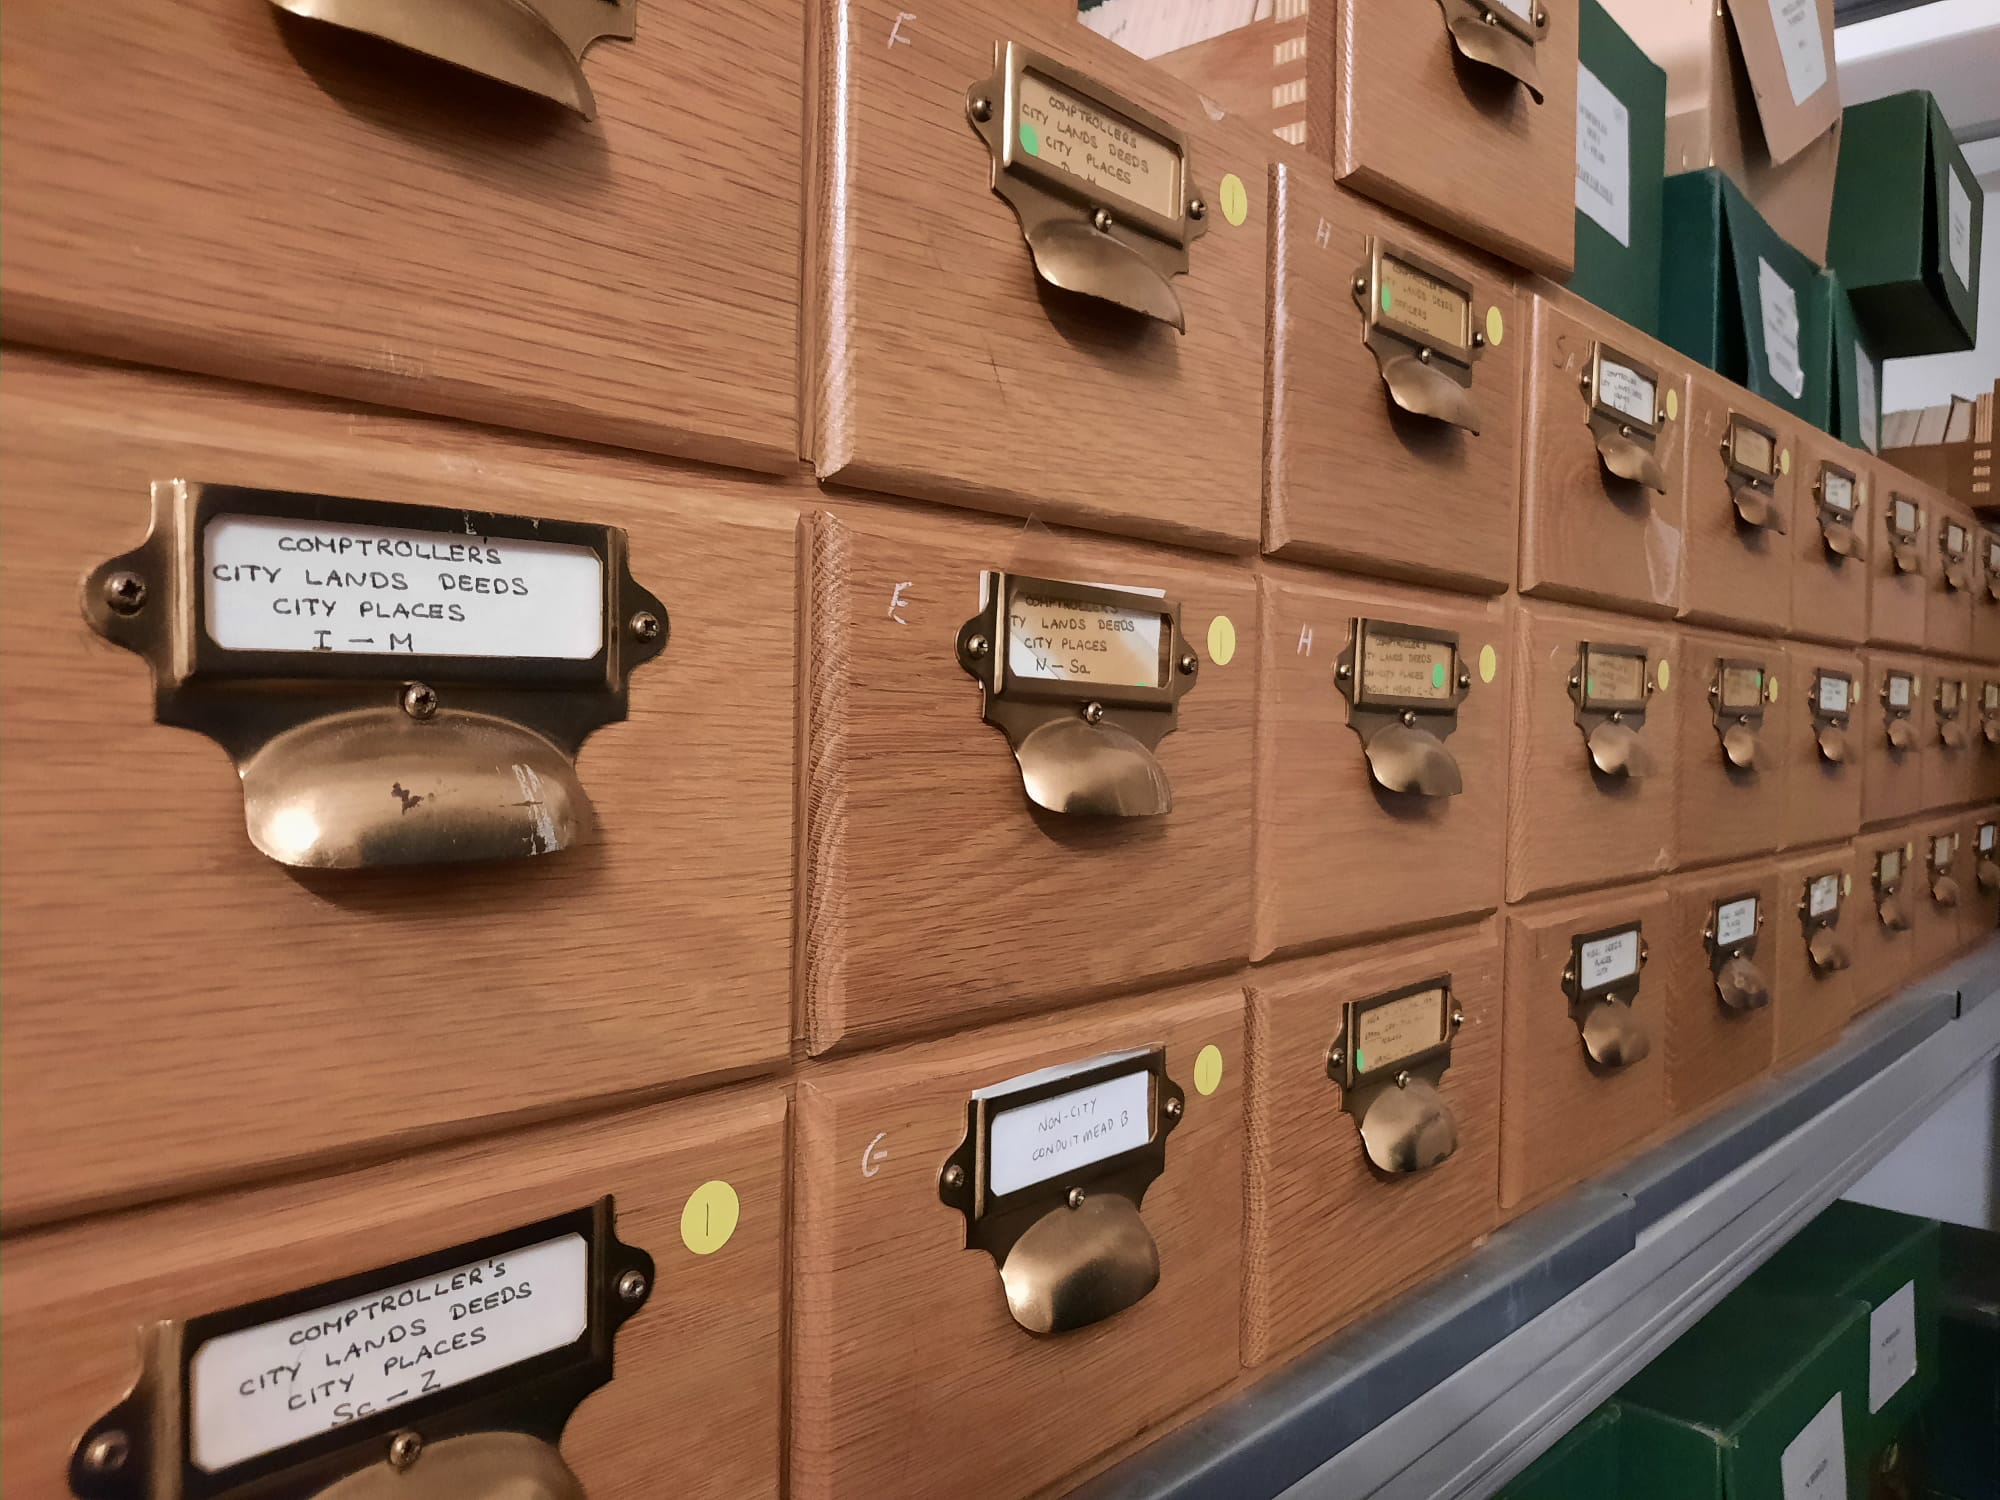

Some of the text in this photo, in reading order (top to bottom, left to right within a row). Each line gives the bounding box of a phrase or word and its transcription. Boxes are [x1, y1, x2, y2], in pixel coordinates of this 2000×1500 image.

[1022, 103, 1149, 175] CITY LANDS DEEDS
[1045, 135, 1131, 185] CITY PLACES
[212, 564, 529, 595] CITY LANDS DEEDS
[273, 598, 465, 622] CITY PLACES
[1010, 614, 1135, 632] TY LANDS DEEDS
[389, 633, 414, 652] M
[1023, 636, 1108, 652] CITY PLACES
[1038, 1097, 1097, 1133] NON-CITY
[238, 1282, 533, 1396] CITY LANDS DEEDS
[288, 1326, 486, 1411] CITY PLACES
[421, 1369, 441, 1393] Z
